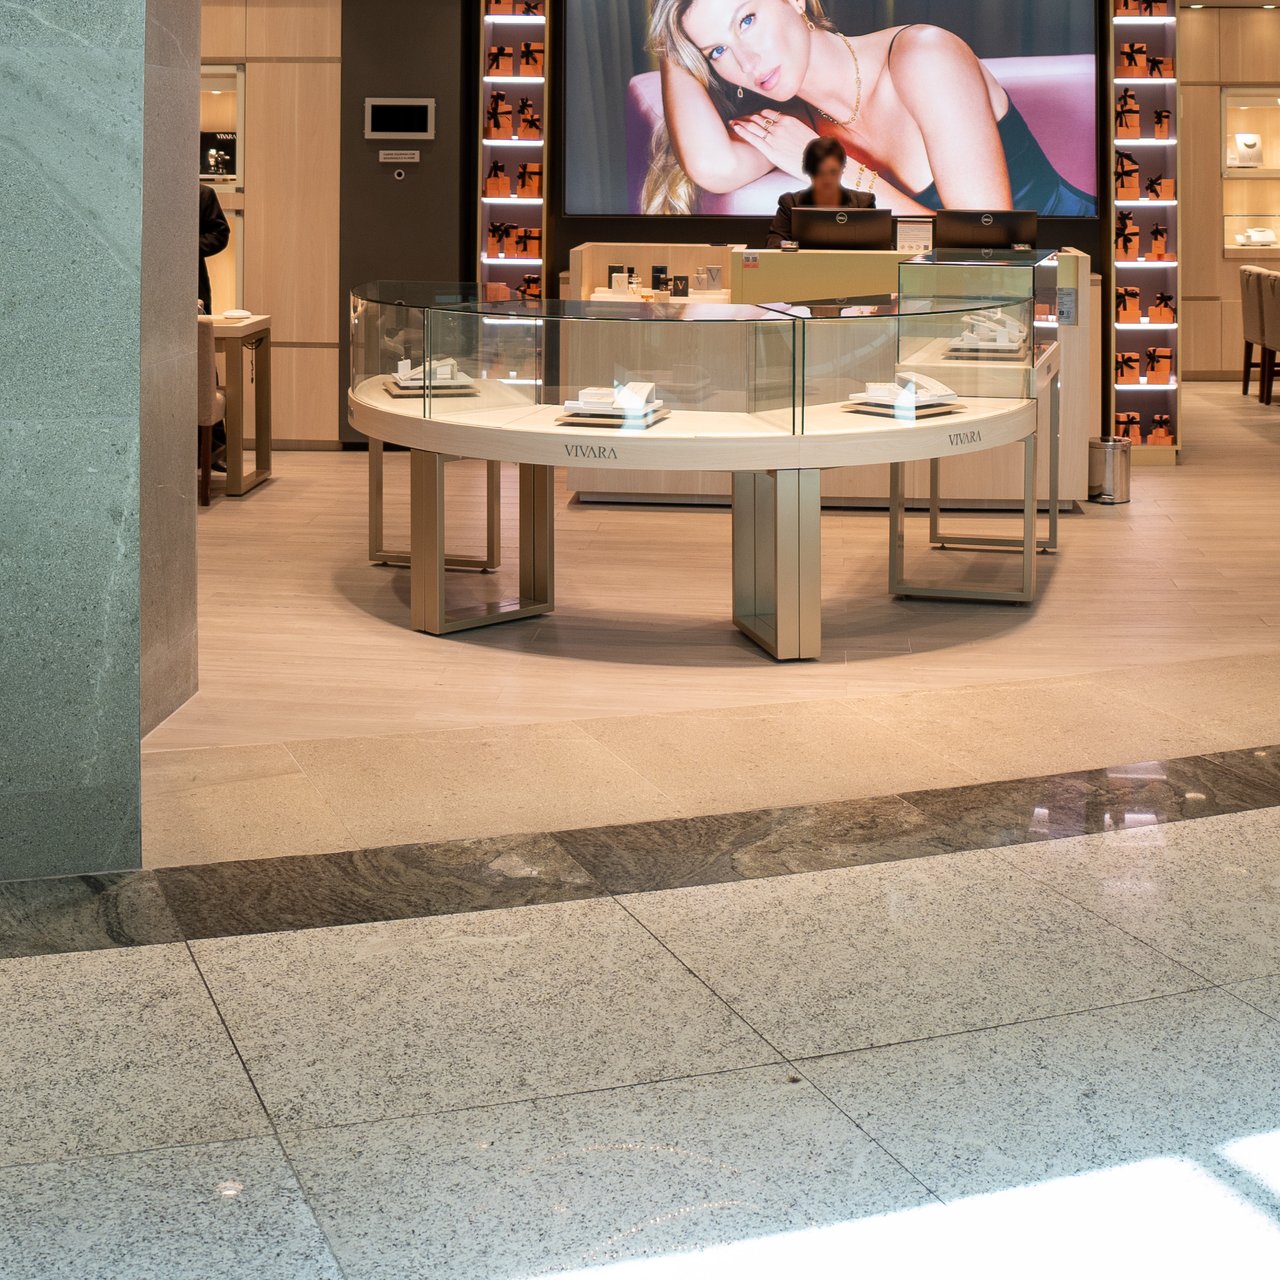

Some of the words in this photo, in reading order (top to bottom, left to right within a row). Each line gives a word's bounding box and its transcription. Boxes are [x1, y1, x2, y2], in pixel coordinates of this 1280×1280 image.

[676, 280, 686, 290] V
[948, 429, 982, 446] VIVARA
[564, 444, 618, 460] VIVARA
